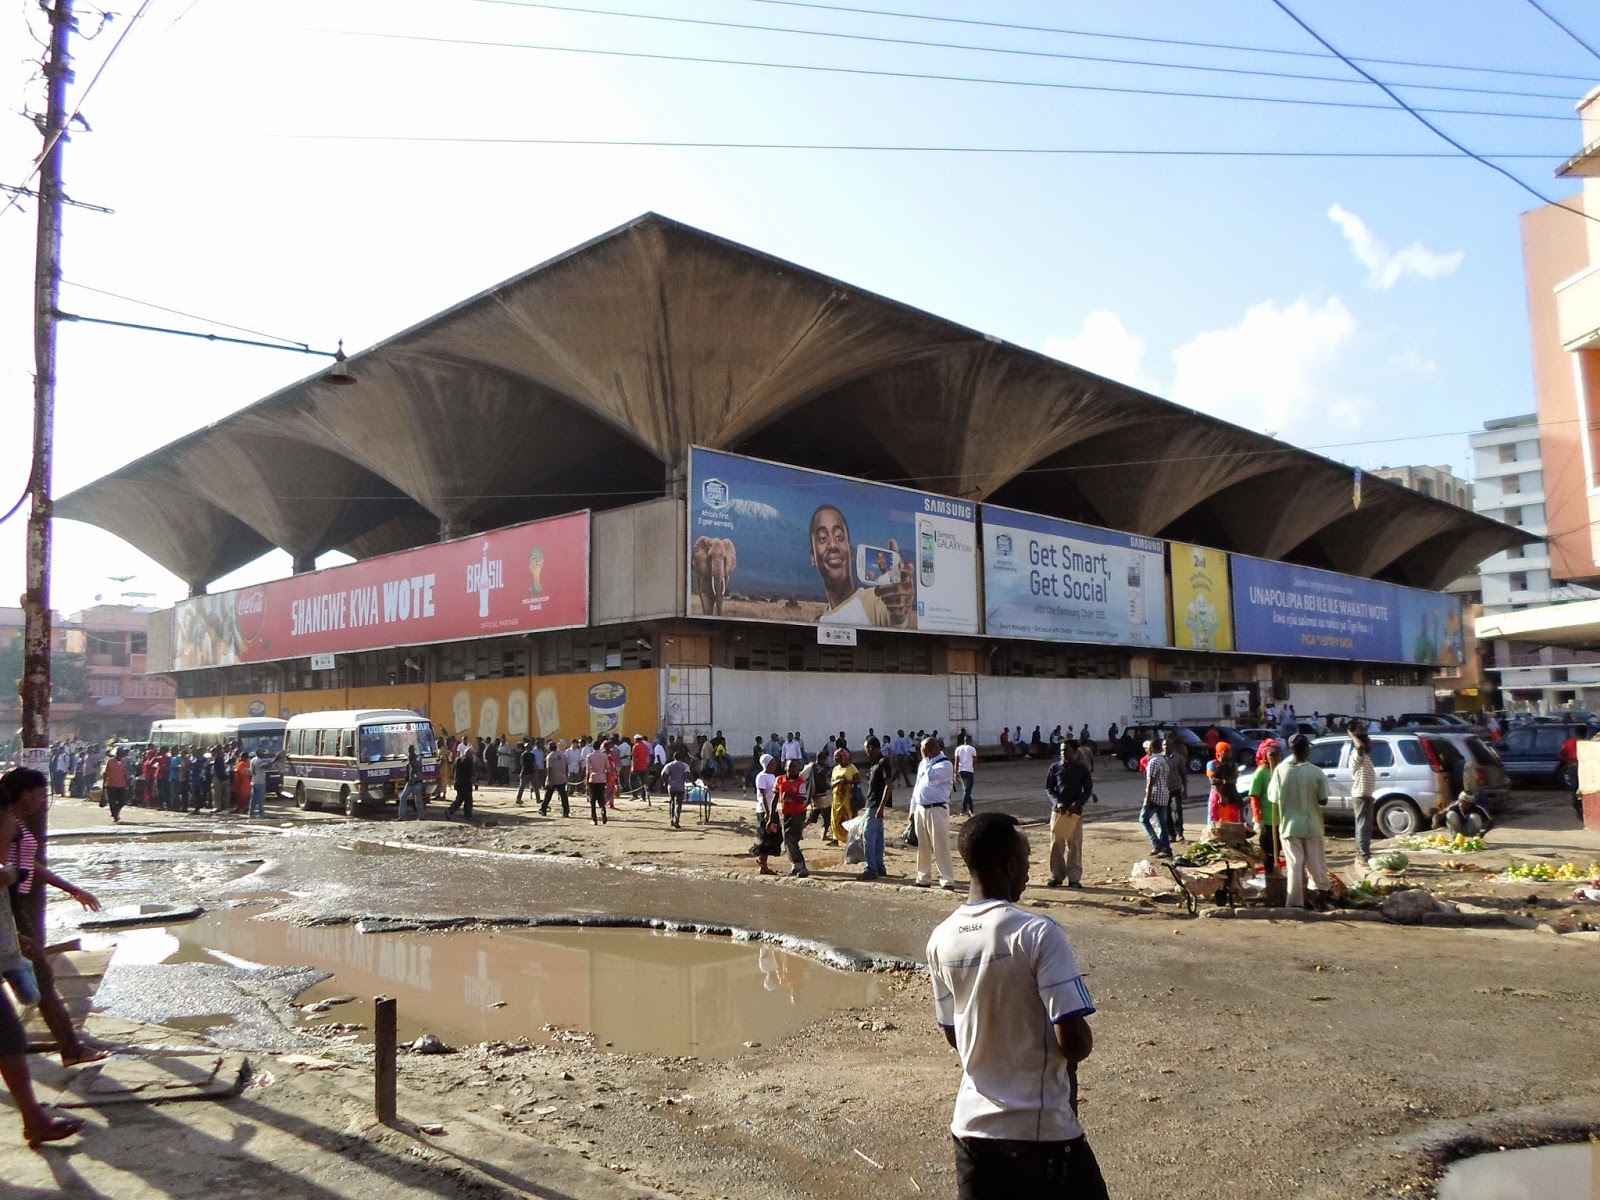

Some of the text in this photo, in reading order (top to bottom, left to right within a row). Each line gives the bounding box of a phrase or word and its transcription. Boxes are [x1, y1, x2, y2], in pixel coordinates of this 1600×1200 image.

[924, 498, 971, 519] SAMSUNG
[1029, 540, 1058, 568] Get
[1062, 545, 1112, 581] Smart,
[1130, 536, 1162, 552] SAMSUNG
[1030, 570, 1107, 604] Get Social
[1250, 586, 1303, 610] UNAPOLIPIA
[1339, 600, 1368, 619] WAKATI
[1368, 604, 1388, 621] WOTE
[291, 574, 435, 636] SHANGWE KWA WOTE
[958, 923, 983, 934] CHELSEA
